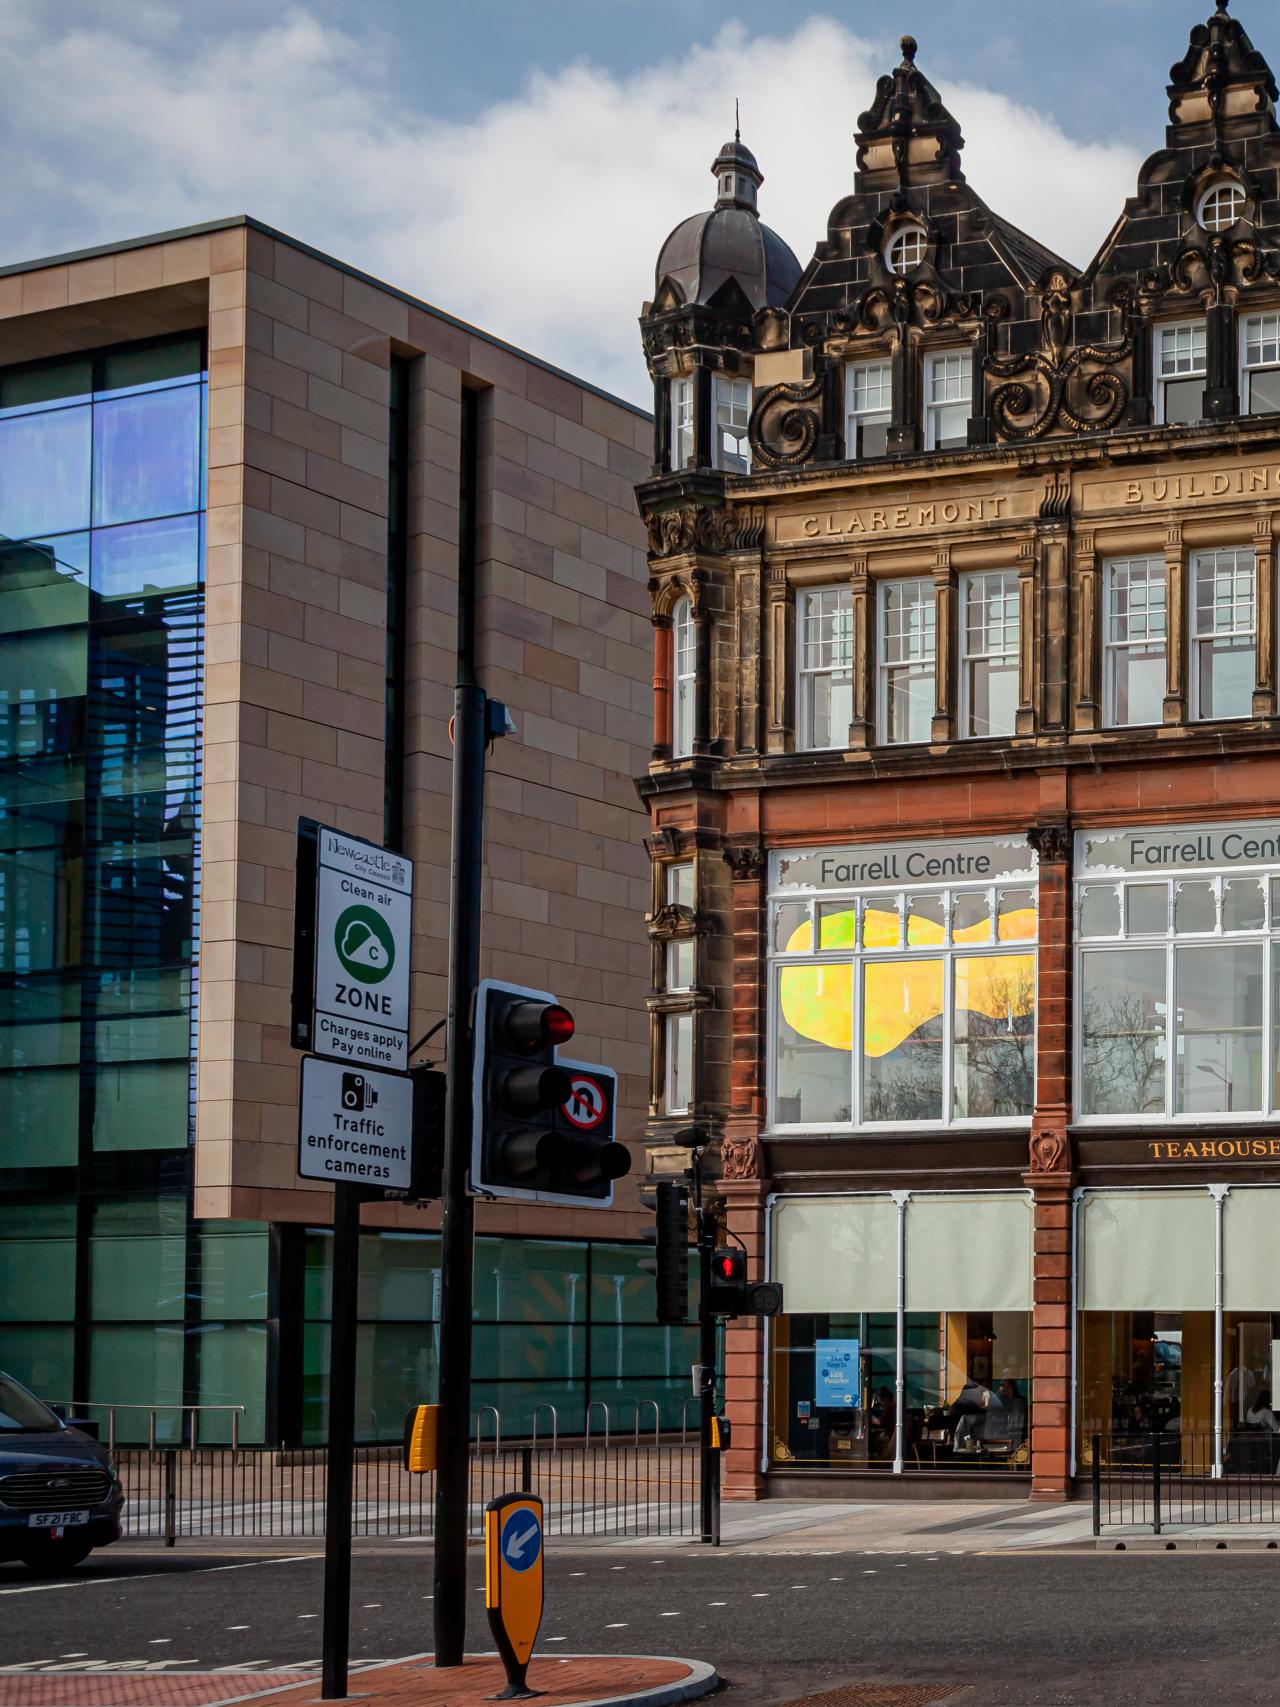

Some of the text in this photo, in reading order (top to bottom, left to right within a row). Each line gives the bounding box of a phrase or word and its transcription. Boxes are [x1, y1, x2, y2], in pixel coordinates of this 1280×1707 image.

[802, 497, 1006, 537] CLAREMONT
[328, 837, 391, 872] Newcastle
[1130, 836, 1215, 865] Farrell
[354, 863, 391, 881] City Council
[821, 852, 990, 883] Farrell Centre
[341, 880, 392, 906] Clean air
[369, 946, 379, 961] C
[335, 983, 392, 1016] ZONE
[320, 1019, 403, 1050] Charges apply
[332, 1038, 392, 1061] Pay online
[333, 1113, 385, 1137] Traffic
[307, 1134, 406, 1160] enforcement
[325, 1159, 390, 1178] cameras
[36, 1514, 61, 1525] SF21
